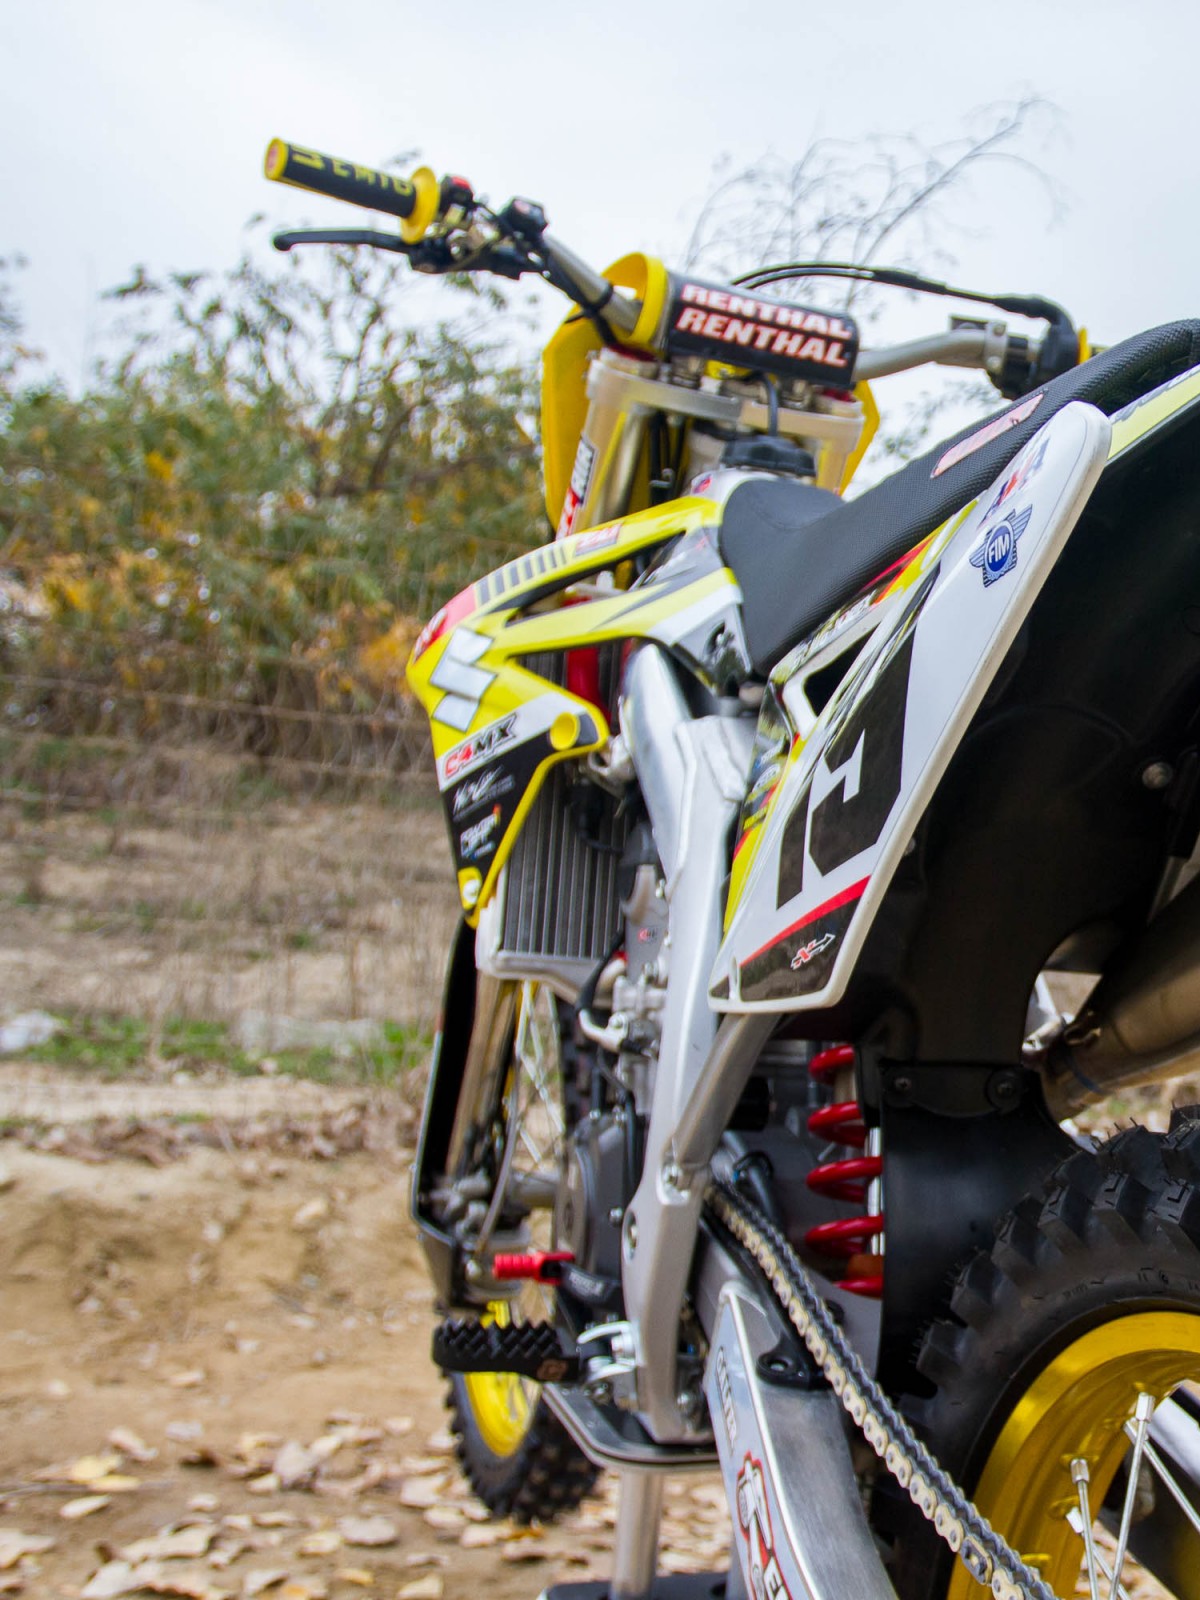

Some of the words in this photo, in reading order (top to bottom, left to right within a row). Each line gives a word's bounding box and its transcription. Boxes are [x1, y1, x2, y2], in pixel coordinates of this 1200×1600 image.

[675, 306, 848, 368] RENTHAL
[680, 283, 851, 339] RENTHAL
[988, 533, 1011, 564] FIM
